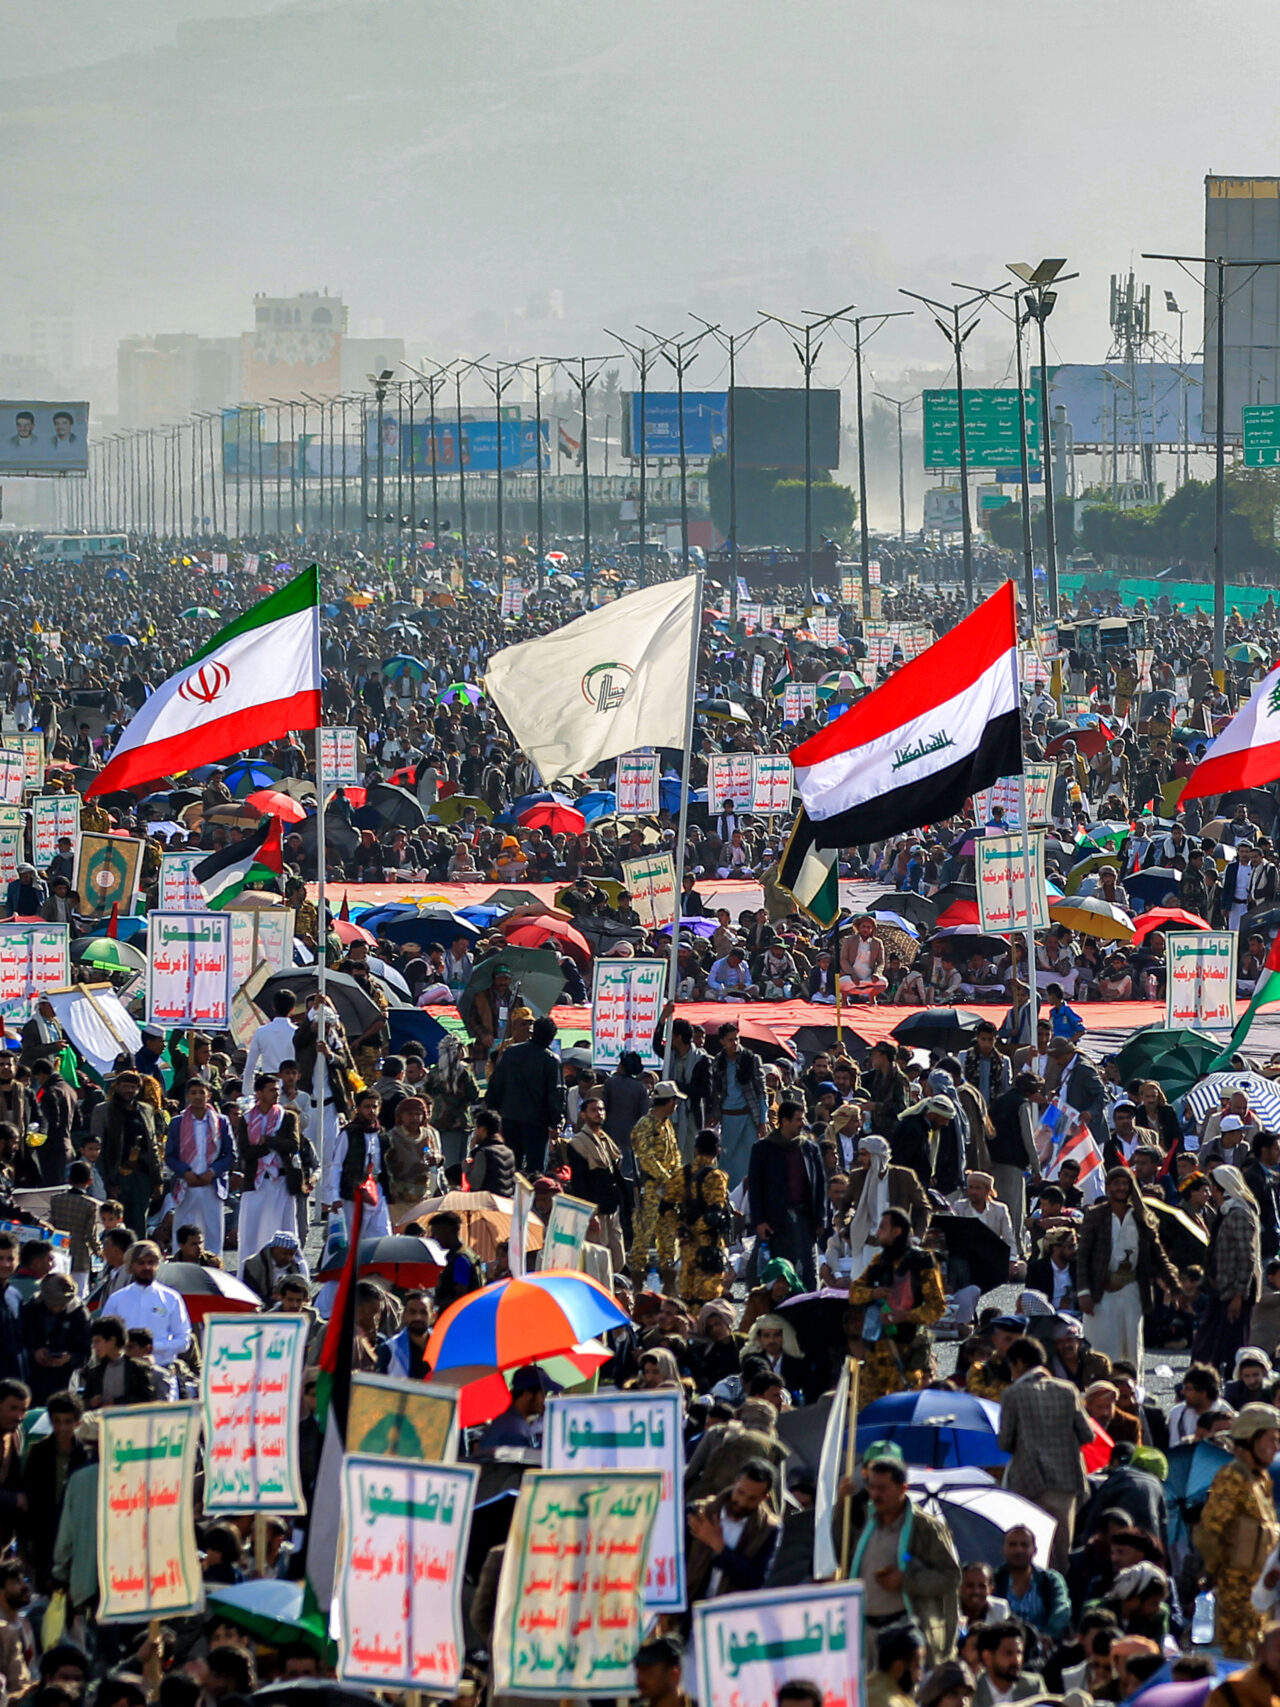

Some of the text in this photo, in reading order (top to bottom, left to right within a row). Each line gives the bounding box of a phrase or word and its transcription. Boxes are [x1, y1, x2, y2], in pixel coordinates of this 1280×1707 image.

[159, 919, 222, 947] قاطعوا
[1173, 939, 1229, 961] قاطعوا
[637, 968, 660, 984] الله
[266, 1331, 292, 1360] الله
[109, 1424, 187, 1473] قاطعوا
[563, 1408, 665, 1458] قاطعوا
[358, 1473, 459, 1527] قاطعوا
[610, 1487, 653, 1519] الله
[718, 1609, 847, 1677] قاطعوا
